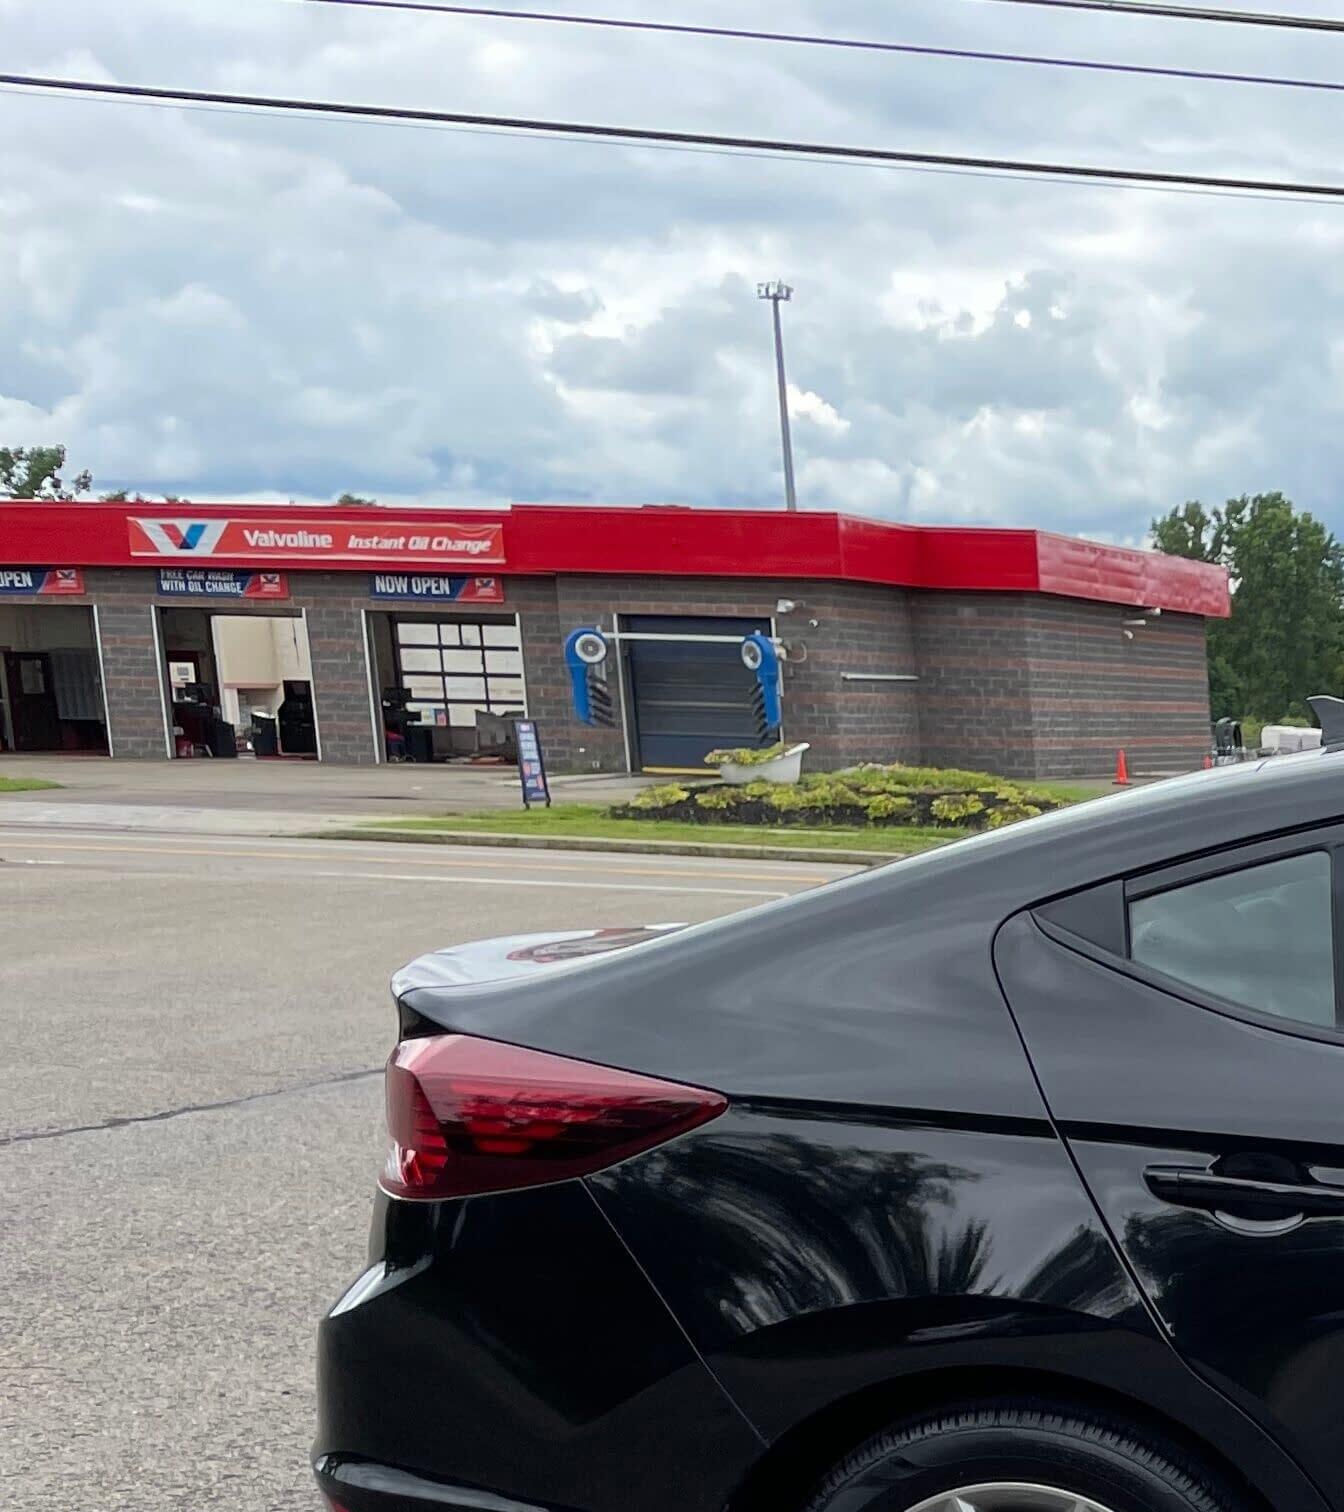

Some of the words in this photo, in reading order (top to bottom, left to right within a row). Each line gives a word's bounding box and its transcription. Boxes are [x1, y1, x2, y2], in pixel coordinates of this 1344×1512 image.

[243, 529, 333, 548] Valvoline
[347, 534, 405, 550] Instant
[407, 536, 429, 550] Oil
[431, 536, 492, 554] Change
[160, 569, 184, 579] FREE
[160, 580, 186, 592] WITH
[188, 581, 204, 593] OIL
[205, 581, 243, 594] CHANGE
[375, 575, 408, 594] NOW
[411, 577, 450, 595] OPEN
